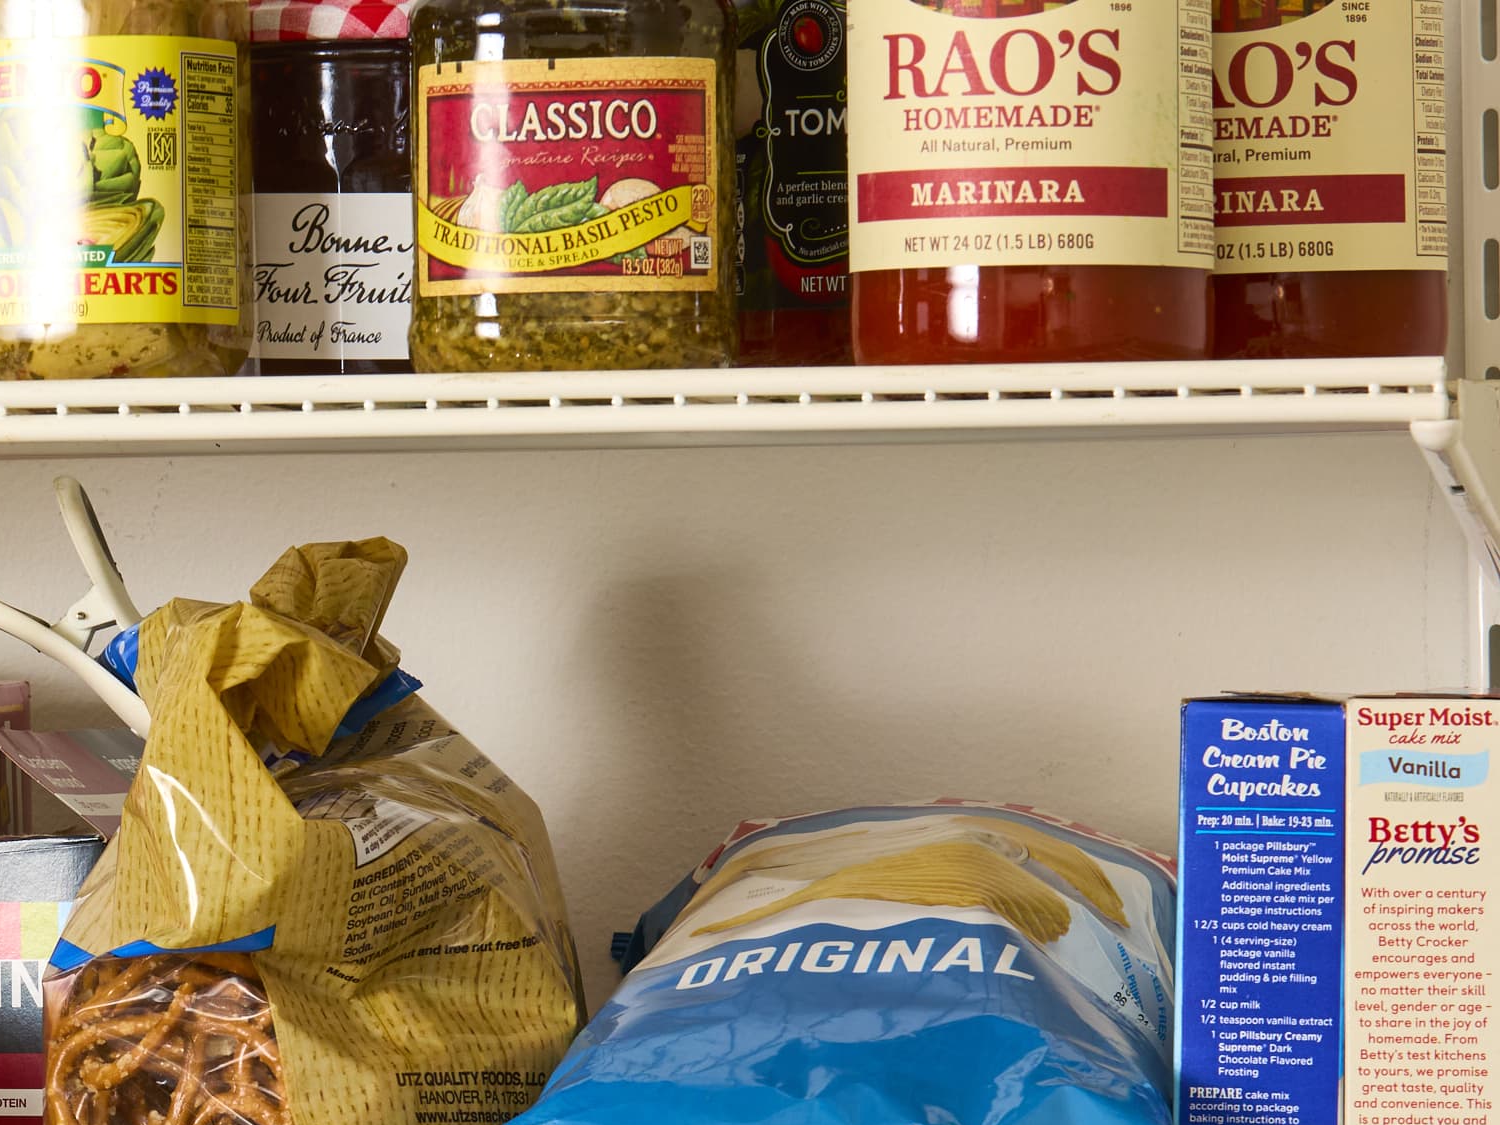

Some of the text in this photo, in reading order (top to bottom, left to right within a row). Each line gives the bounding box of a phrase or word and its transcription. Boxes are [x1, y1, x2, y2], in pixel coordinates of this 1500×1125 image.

[1342, 2, 1370, 11] SINCE
[1346, 14, 1367, 23] 1896
[883, 29, 1122, 101] RAO'S
[471, 100, 656, 141] CLASSICO
[921, 138, 1072, 153] All Natural, Premium
[911, 180, 1084, 206] MARINARA
[563, 196, 678, 250] BASIL PESTO
[905, 233, 1094, 251] NET WT 24 OZ (1.5 LB) 680G
[622, 261, 683, 276] 13.5 OZ (382g)
[258, 320, 381, 349] Product of France
[1358, 707, 1492, 729] Super Moist
[1221, 719, 1308, 742] Boston
[1203, 746, 1326, 769] Cream Pie
[1389, 757, 1460, 778] Vanilla
[1208, 775, 1321, 802] Cupcakes
[1369, 816, 1480, 849] Betty's
[1222, 867, 1310, 876] Premium Cake Mix
[1361, 888, 1486, 902] With over a century
[676, 937, 1035, 991] ORIGINAL
[425, 1072, 523, 1088] QUALITY FOODS,
[485, 1092, 499, 1104] PA
[502, 1092, 530, 1104] 17331
